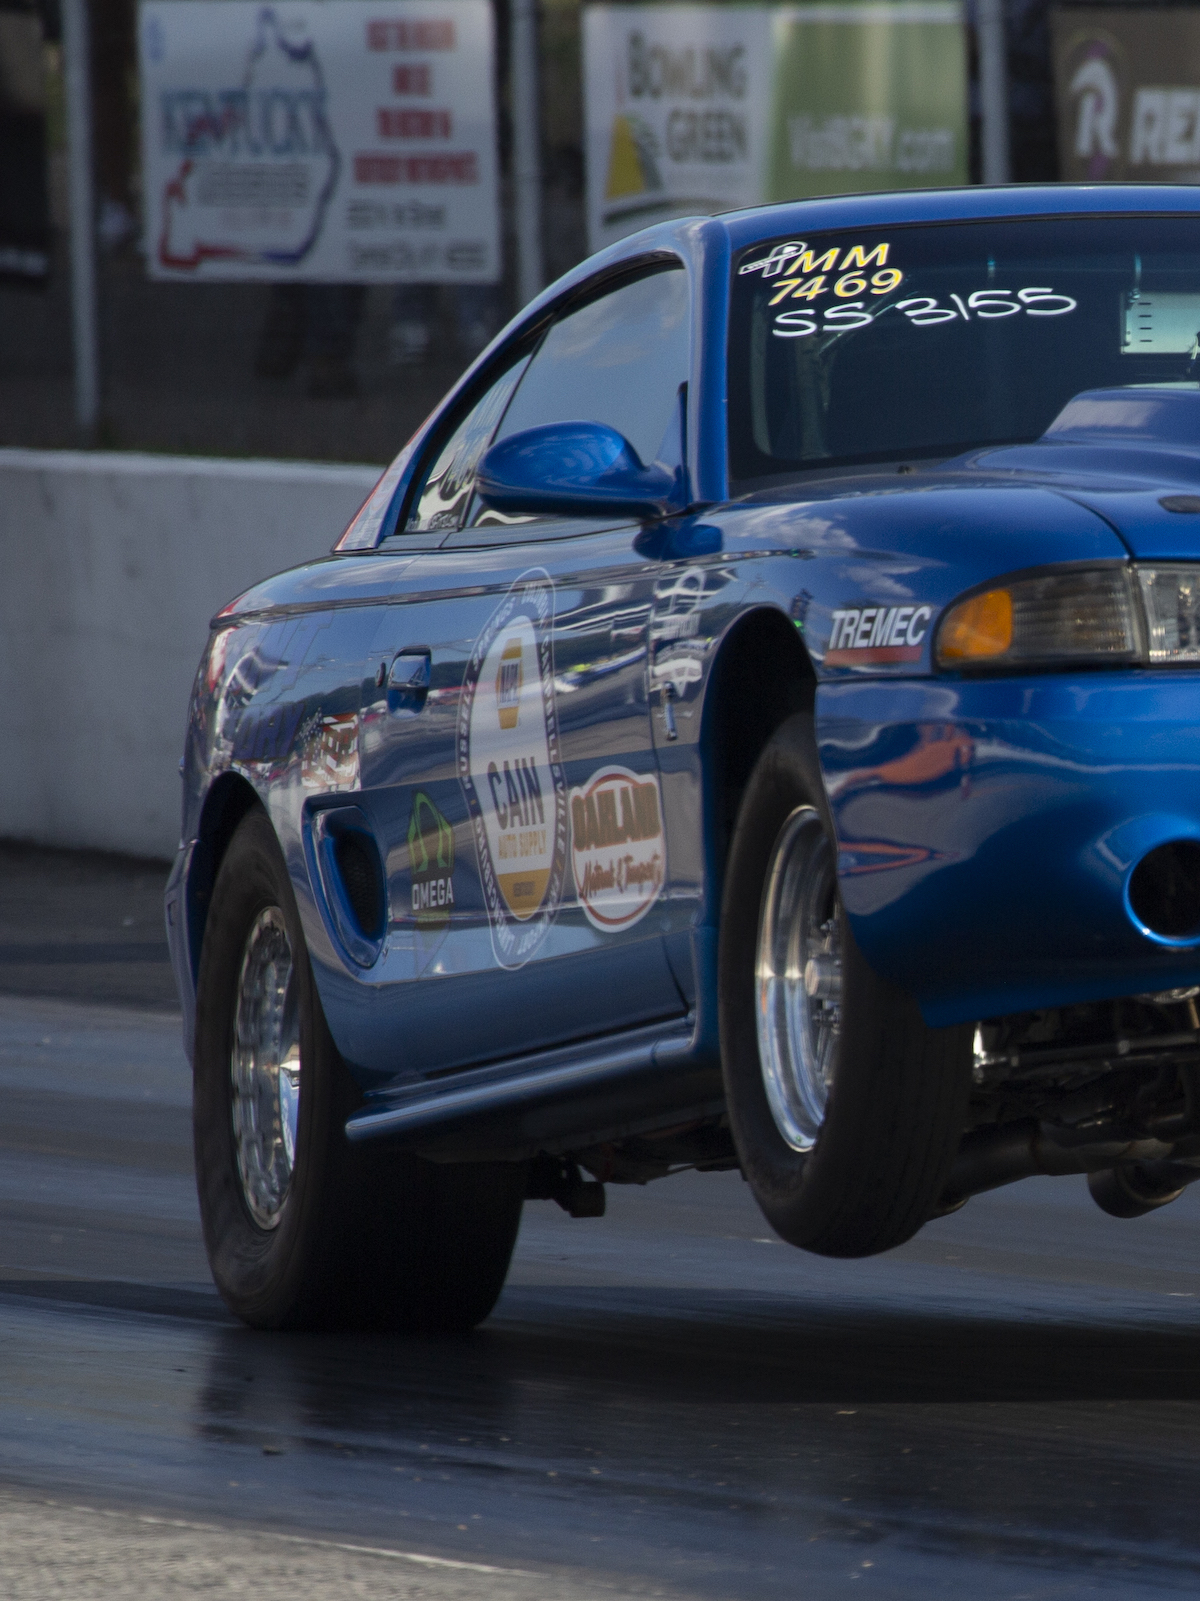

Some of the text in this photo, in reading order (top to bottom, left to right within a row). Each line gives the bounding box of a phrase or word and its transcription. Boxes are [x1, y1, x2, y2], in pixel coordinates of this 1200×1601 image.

[629, 29, 747, 99] BOWLING
[667, 107, 748, 163] GREEN
[768, 268, 903, 306] 7469
[773, 287, 1077, 337] SS 3155
[828, 606, 932, 649] TREMEC
[487, 756, 545, 831] CAIN
[498, 829, 546, 859] AUTO SUPPLY
[412, 877, 454, 910] OMEGA
